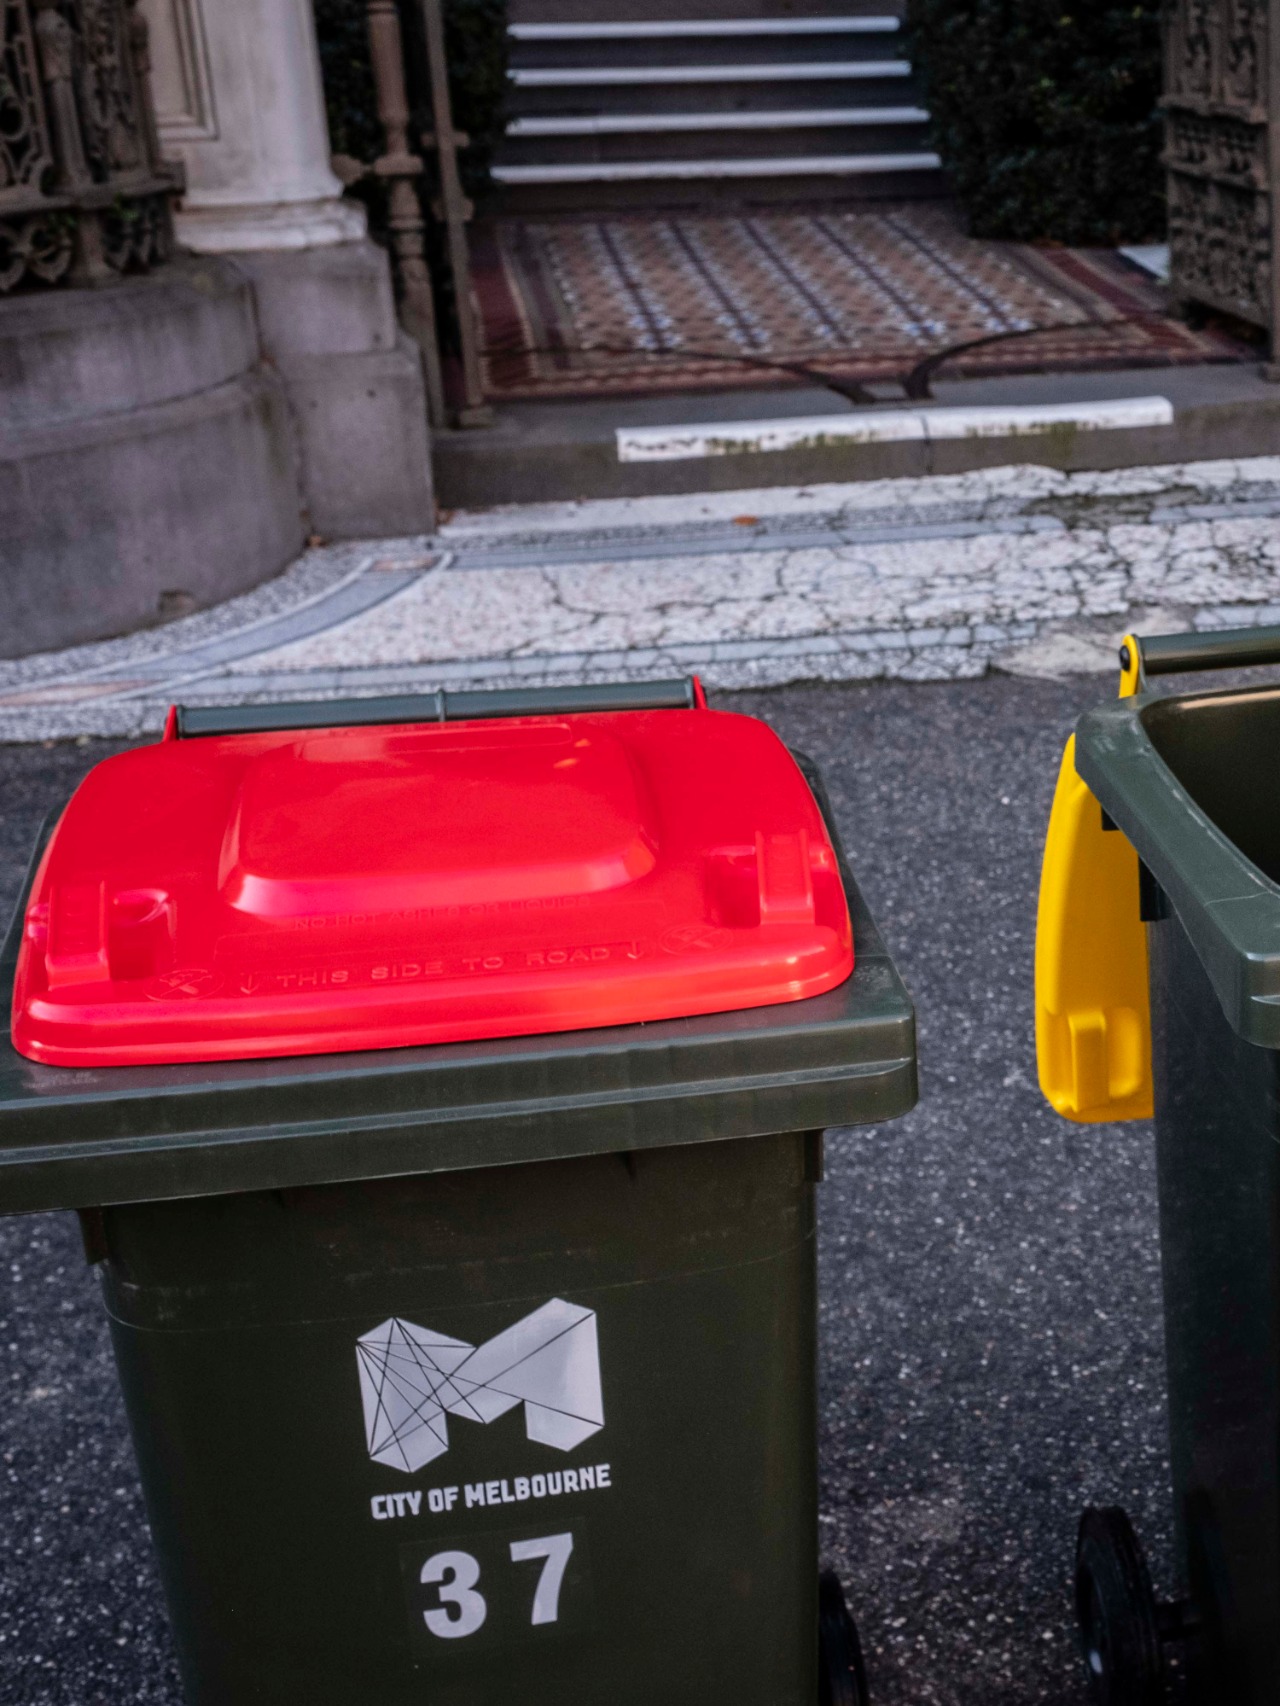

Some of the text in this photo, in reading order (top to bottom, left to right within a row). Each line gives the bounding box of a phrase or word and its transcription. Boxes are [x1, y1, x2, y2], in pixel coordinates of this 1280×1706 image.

[293, 916, 326, 930] NO
[336, 911, 379, 928] HOT
[468, 903, 500, 916] OR
[276, 947, 611, 988] THIS SIDE TO ROAD
[370, 1464, 612, 1520] CITY OF MELBOURNE
